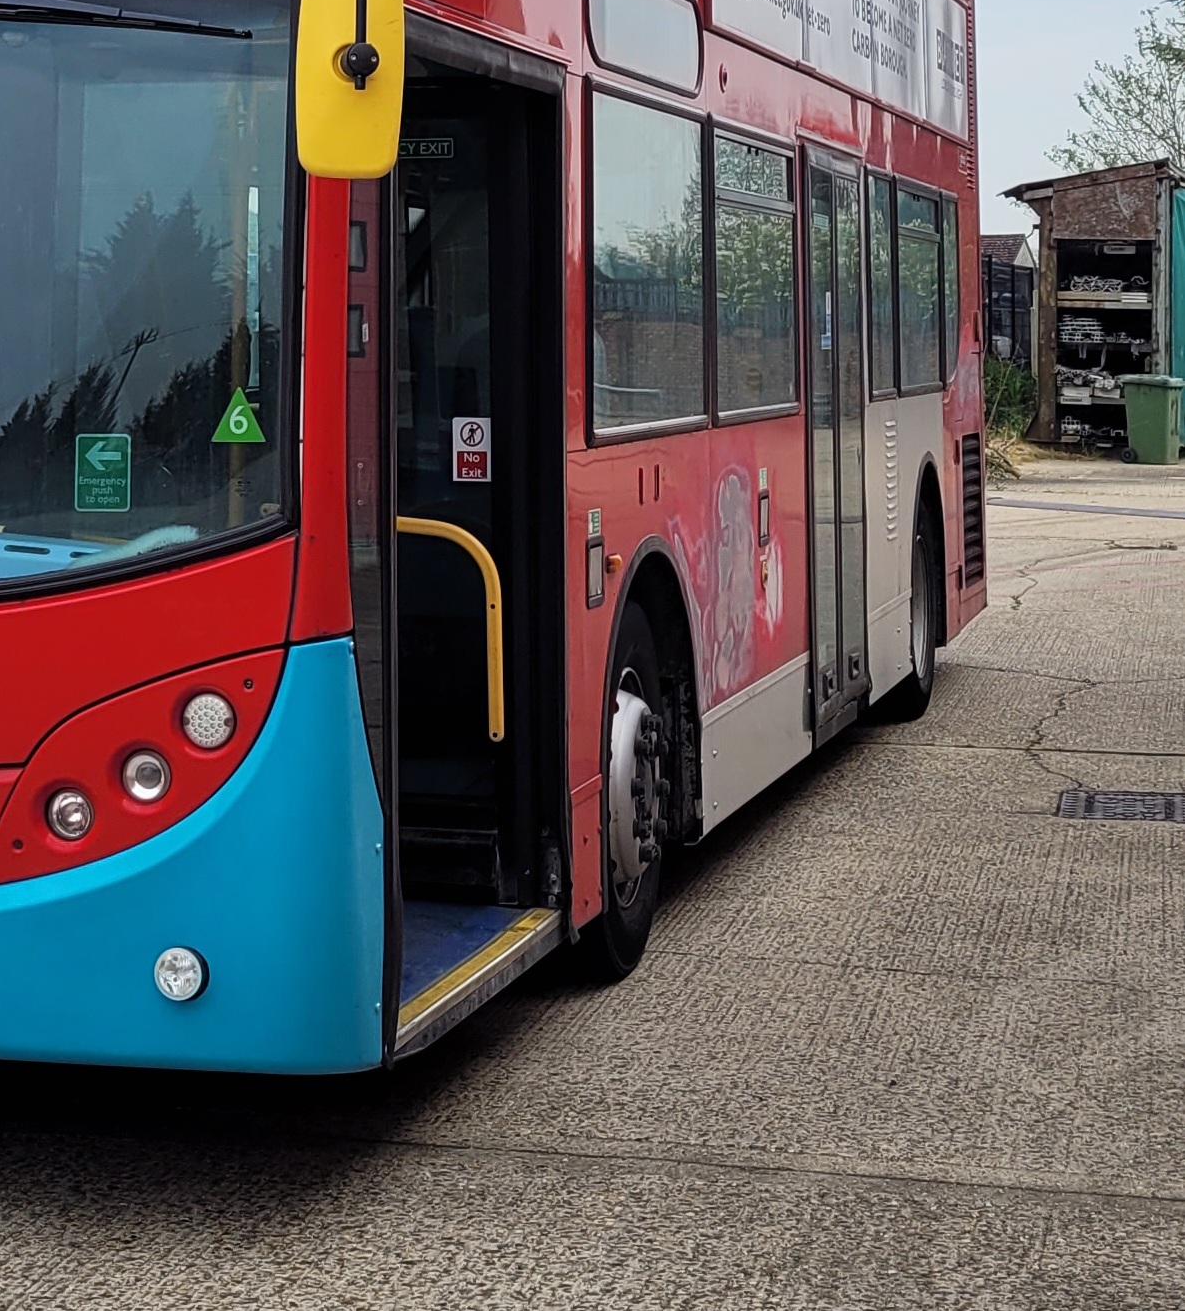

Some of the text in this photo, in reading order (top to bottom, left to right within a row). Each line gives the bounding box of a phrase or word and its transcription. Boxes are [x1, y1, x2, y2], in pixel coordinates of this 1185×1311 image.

[420, 142, 450, 155] EXIT
[229, 405, 248, 435] 6
[463, 452, 480, 463] No
[462, 467, 483, 478] Exit
[79, 476, 126, 487] Emergency
[92, 486, 113, 495] push
[85, 495, 120, 504] to open
